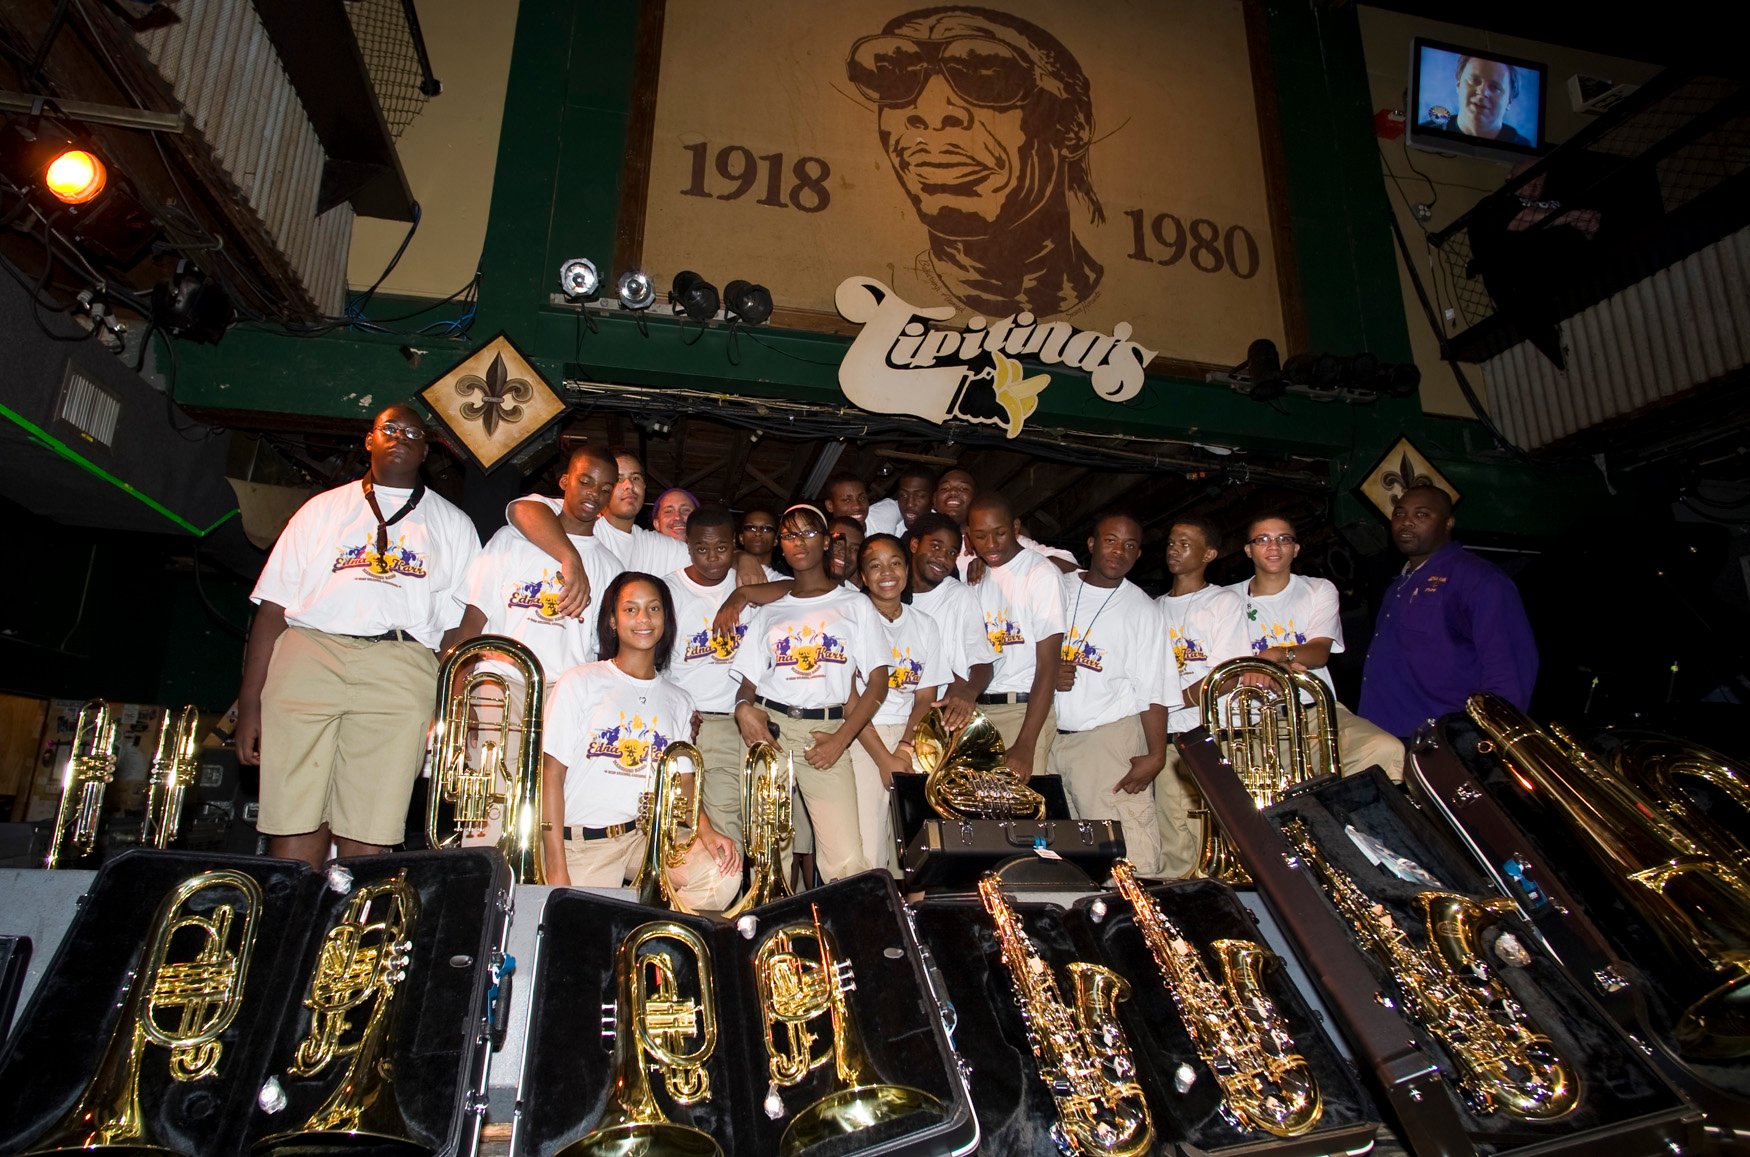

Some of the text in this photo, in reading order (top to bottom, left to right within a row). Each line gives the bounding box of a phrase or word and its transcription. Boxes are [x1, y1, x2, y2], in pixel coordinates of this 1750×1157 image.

[680, 142, 831, 213] 1918
[1123, 208, 1260, 280] 1980
[834, 275, 1160, 425] Tipitina's
[332, 557, 372, 572] Edna
[389, 559, 426, 578] Karr
[508, 592, 544, 608] Edna
[814, 647, 847, 664] Karr
[1072, 651, 1102, 672] Karr
[586, 741, 664, 762] Edna Ka
